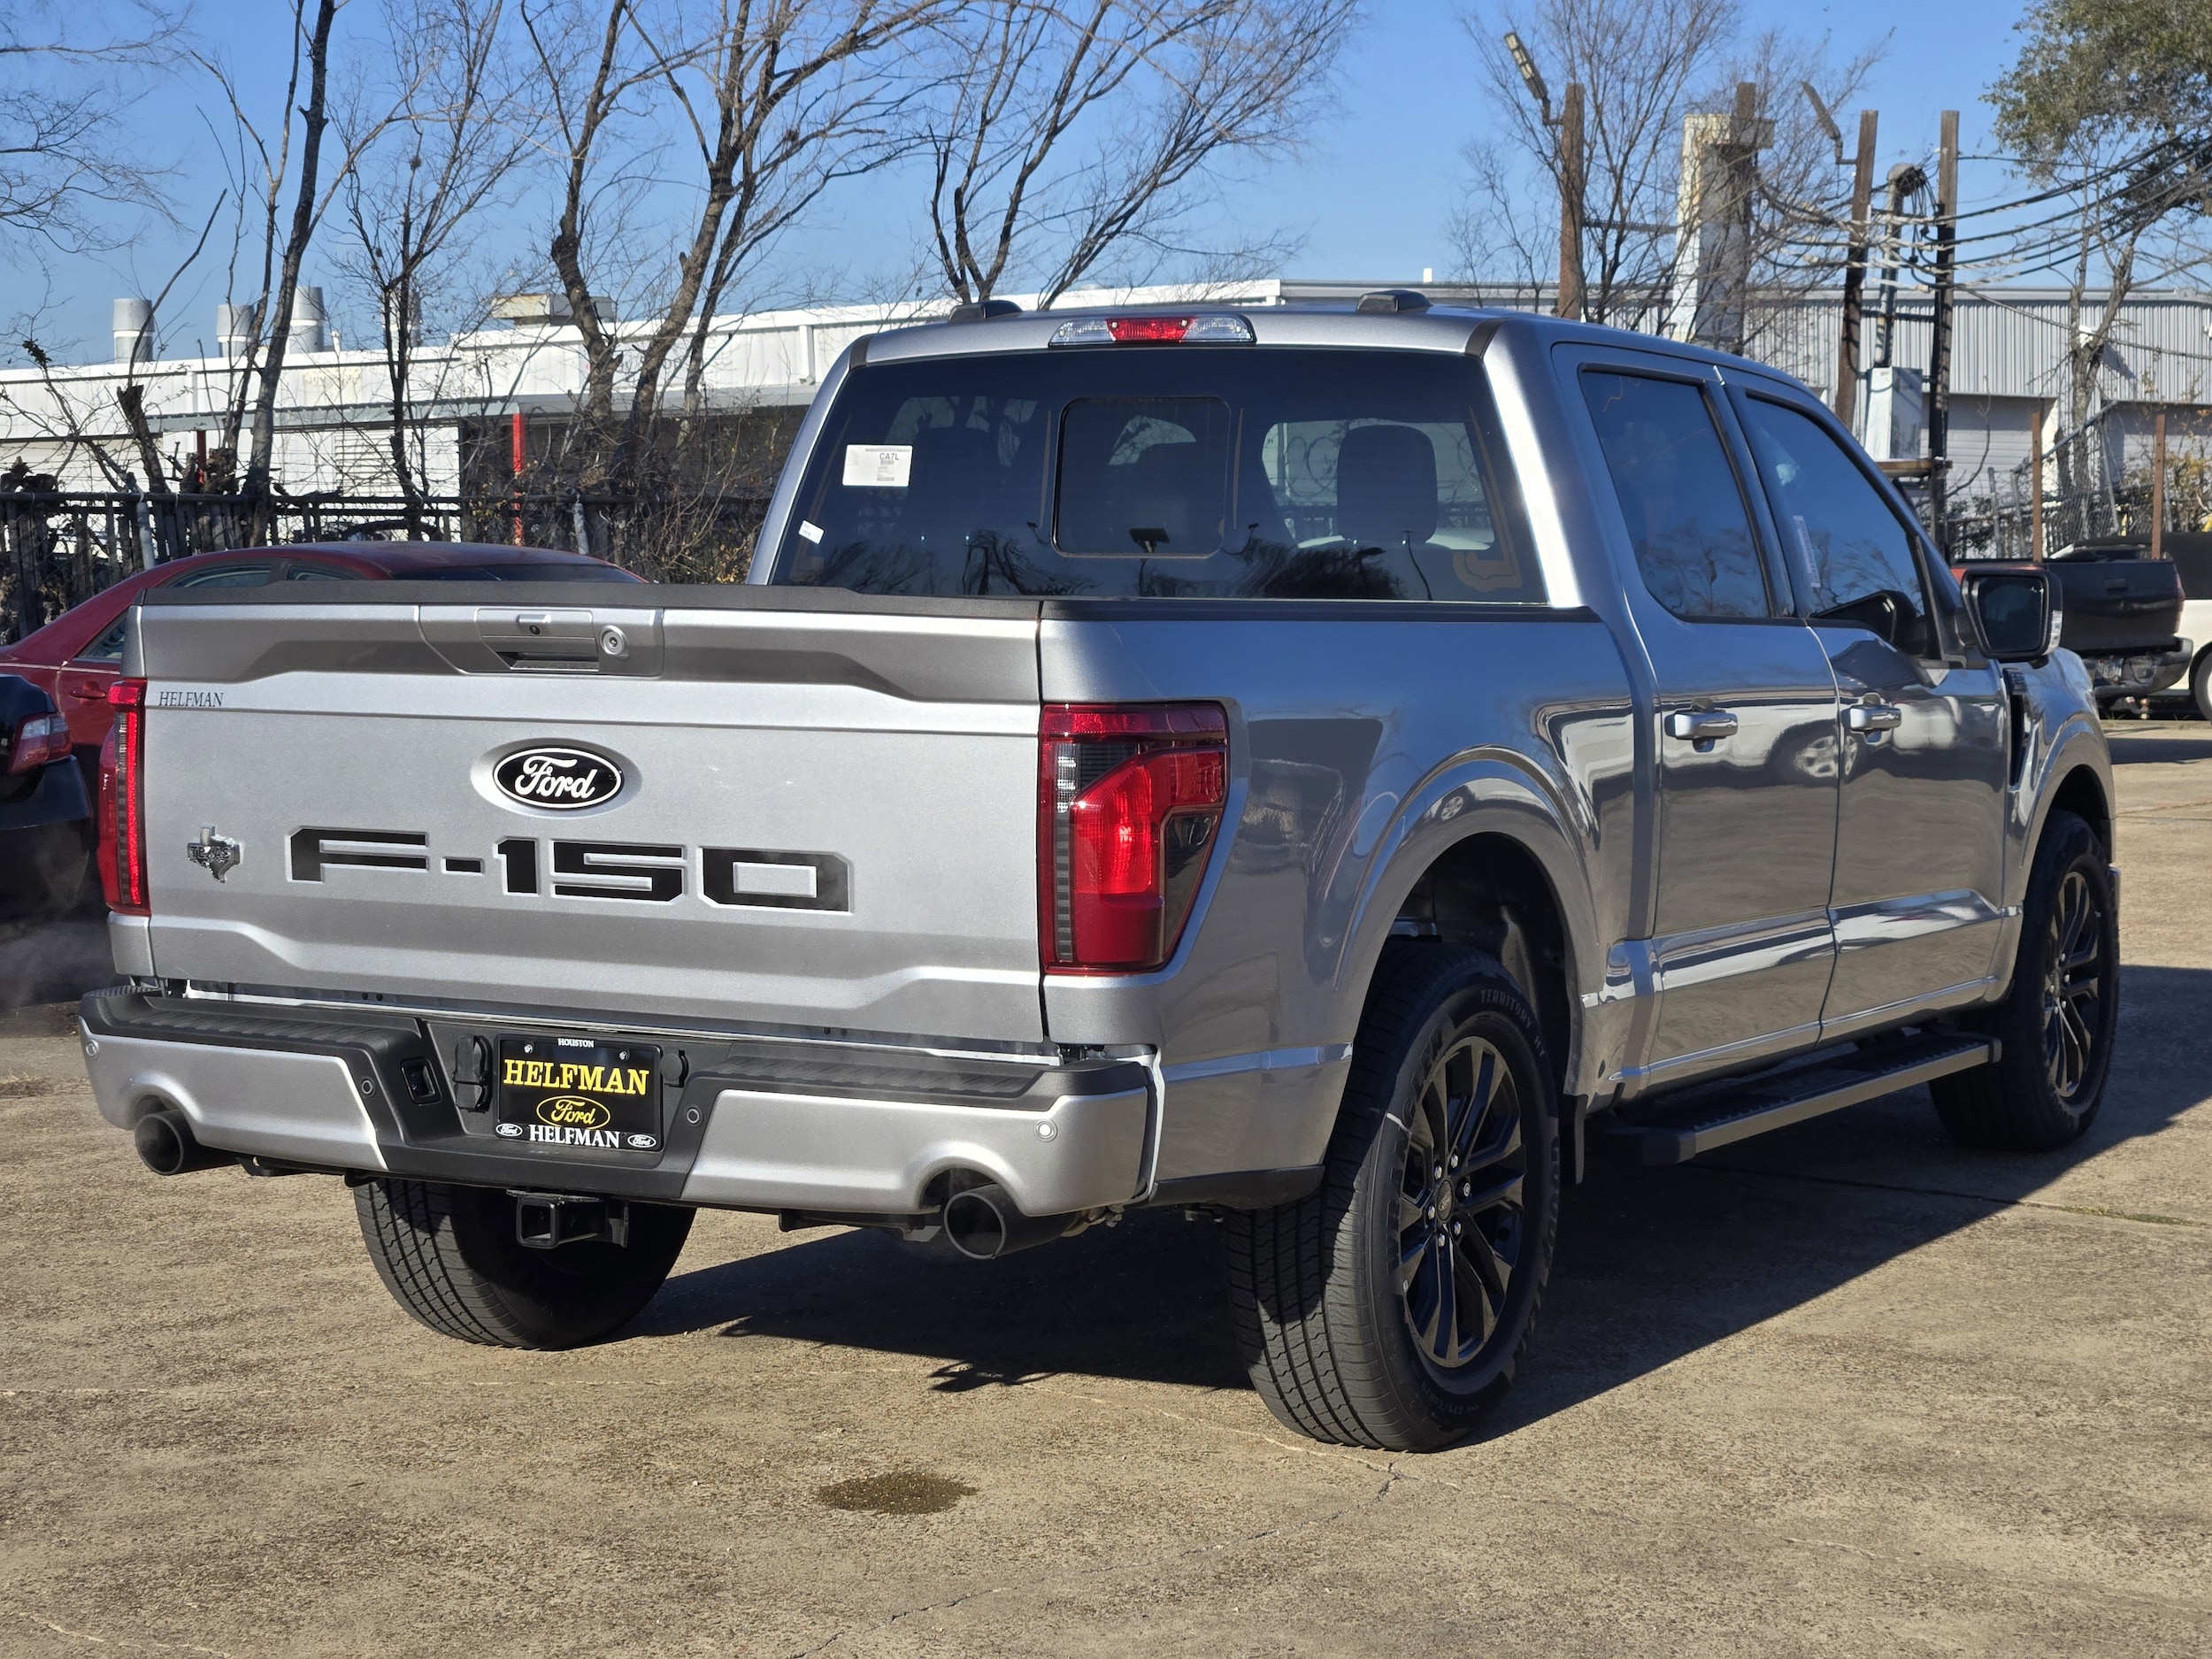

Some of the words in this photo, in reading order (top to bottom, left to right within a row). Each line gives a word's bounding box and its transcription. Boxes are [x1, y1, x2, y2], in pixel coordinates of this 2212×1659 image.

[879, 452, 900, 461] CA7L
[158, 691, 225, 708] HELFMAN
[514, 754, 598, 801] Ford
[289, 827, 851, 913] F-150
[1479, 988, 1532, 1029] TERRITORY
[557, 1037, 595, 1048] HOUSTON
[503, 1058, 649, 1096] HELFMAN
[550, 1098, 595, 1125] Ford
[529, 1124, 620, 1148] HELFMAN
